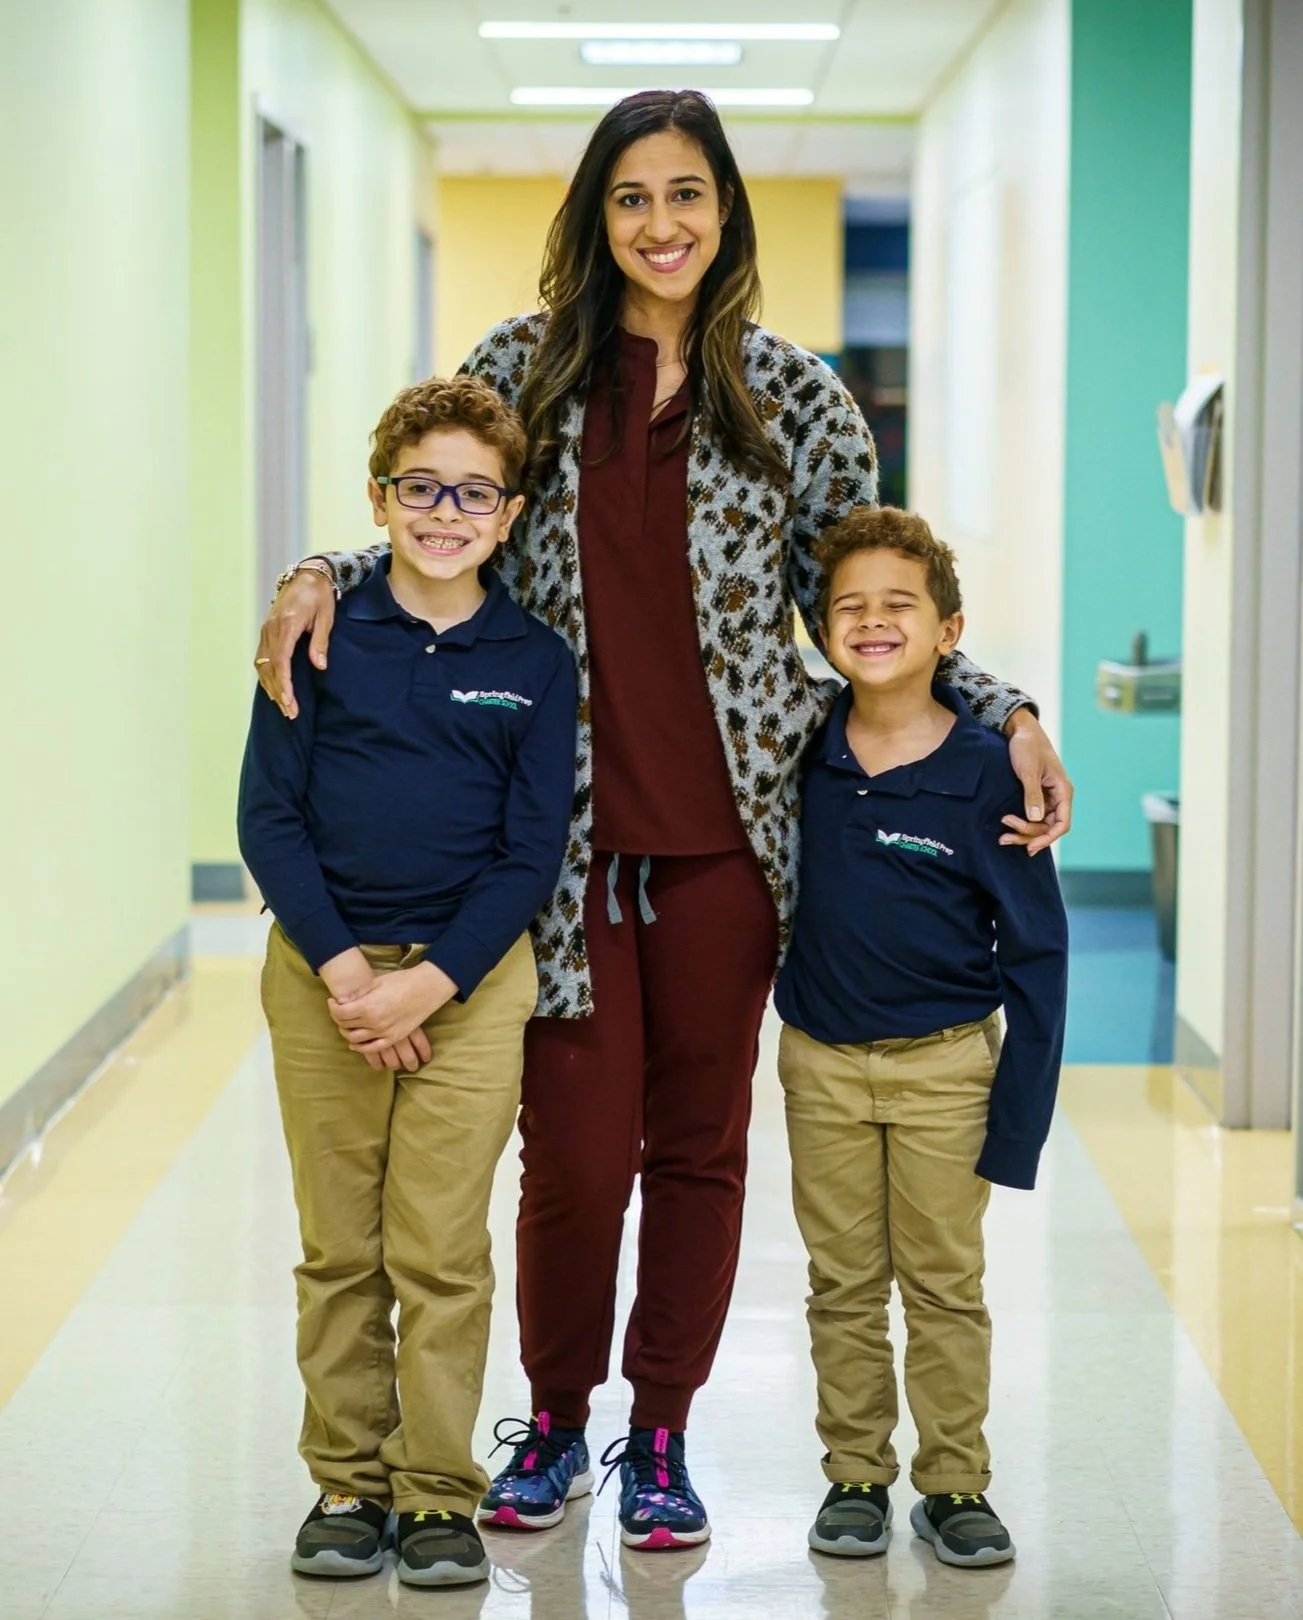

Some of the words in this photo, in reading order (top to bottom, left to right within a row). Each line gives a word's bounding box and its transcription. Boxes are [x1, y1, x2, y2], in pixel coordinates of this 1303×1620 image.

[479, 690, 518, 702] Springfield
[518, 695, 533, 706] Prep
[902, 833, 940, 849] Springfield
[940, 843, 954, 855] Prep
